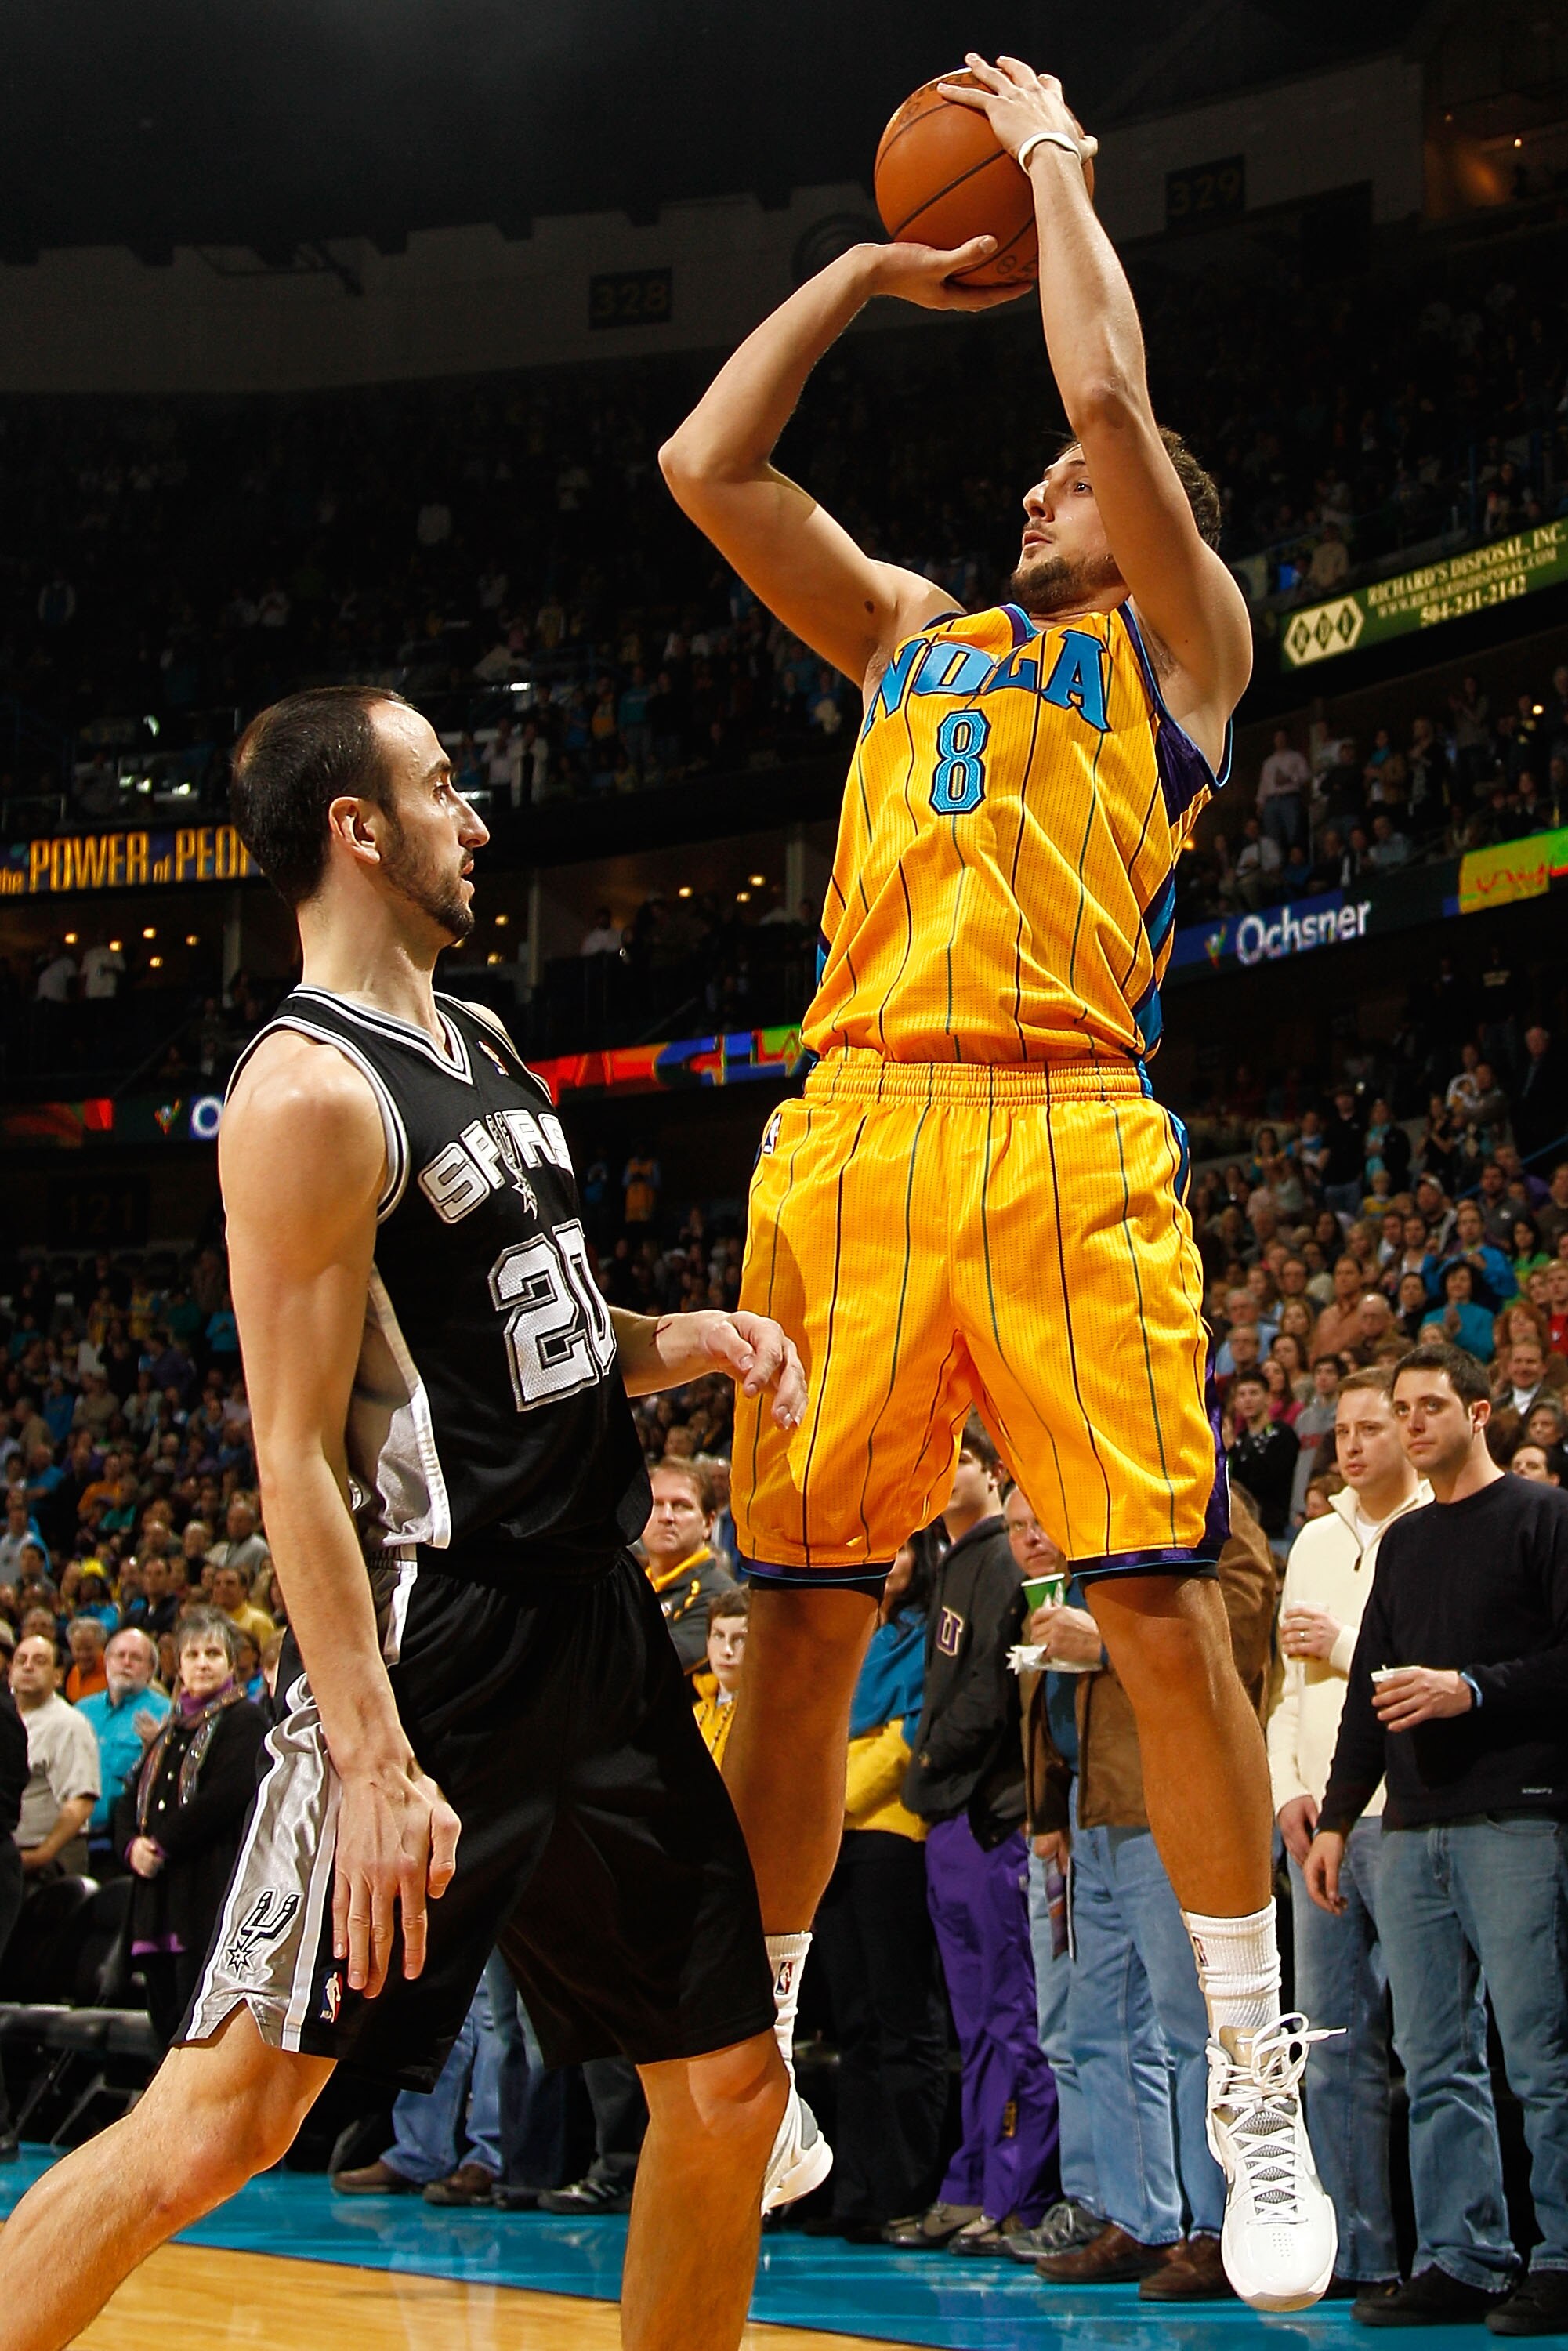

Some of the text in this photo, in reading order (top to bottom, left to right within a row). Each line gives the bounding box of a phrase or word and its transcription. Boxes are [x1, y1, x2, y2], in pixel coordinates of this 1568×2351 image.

[1367, 562, 1449, 606] RICHARD'S
[1533, 522, 1566, 550] INC.
[1420, 574, 1528, 628] 504-241-2142
[861, 629, 1113, 744] NOLA
[929, 708, 991, 816] 8
[29, 831, 149, 893] POWER
[154, 855, 172, 883] of
[1237, 900, 1371, 965] Ochsner
[487, 1218, 617, 1412] 20
[936, 1606, 965, 1657] U
